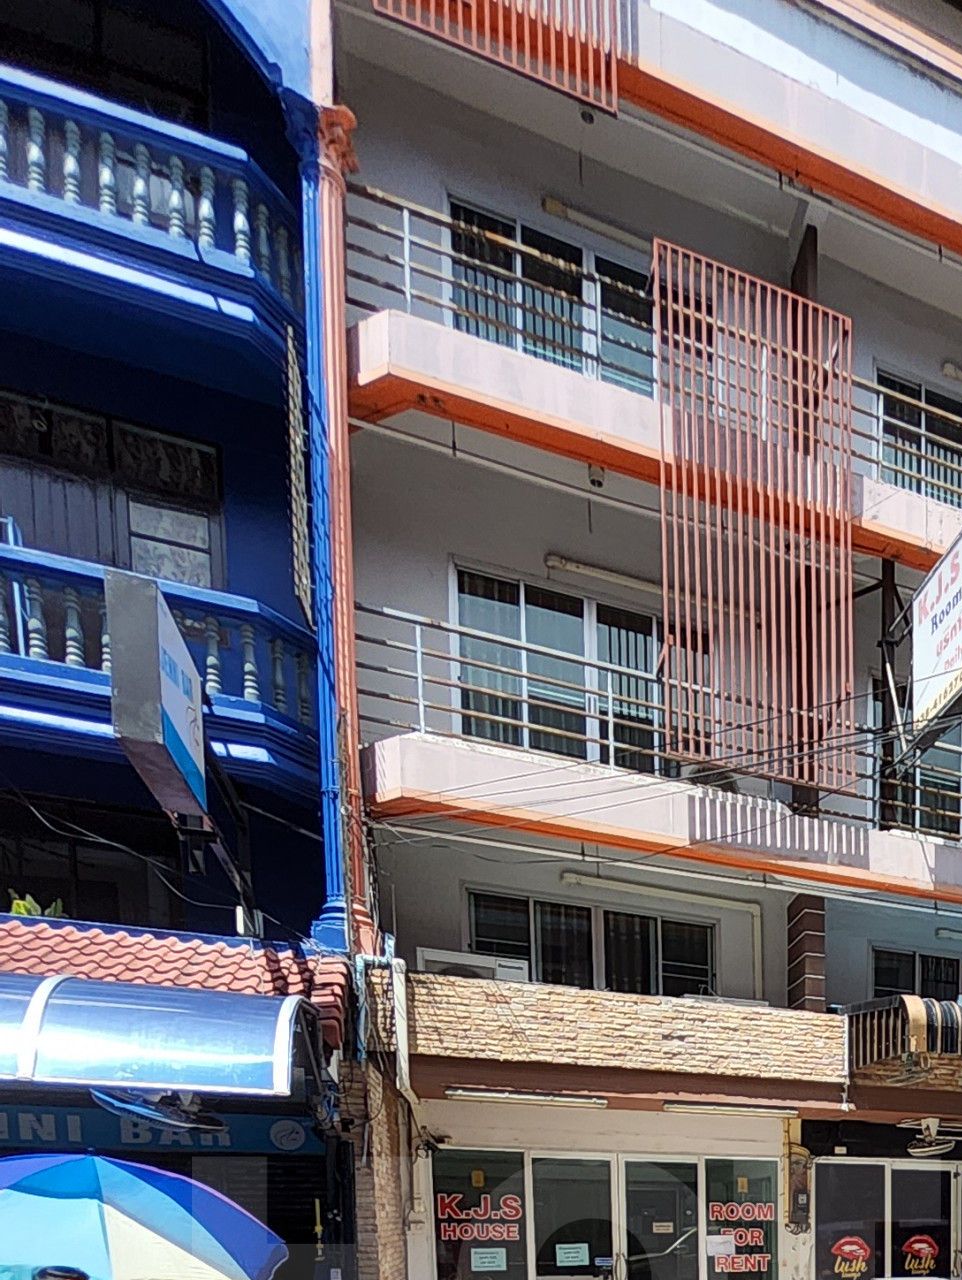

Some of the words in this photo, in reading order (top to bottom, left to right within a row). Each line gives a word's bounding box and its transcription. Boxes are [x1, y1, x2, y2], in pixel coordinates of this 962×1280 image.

[931, 587, 962, 636] Room
[437, 1193, 523, 1219] K.J.S
[709, 1202, 775, 1221] ROOM
[441, 1223, 520, 1241] HOUSE
[714, 1254, 771, 1273] RENT
[834, 1258, 868, 1273] lush
[904, 1254, 937, 1270] lush
